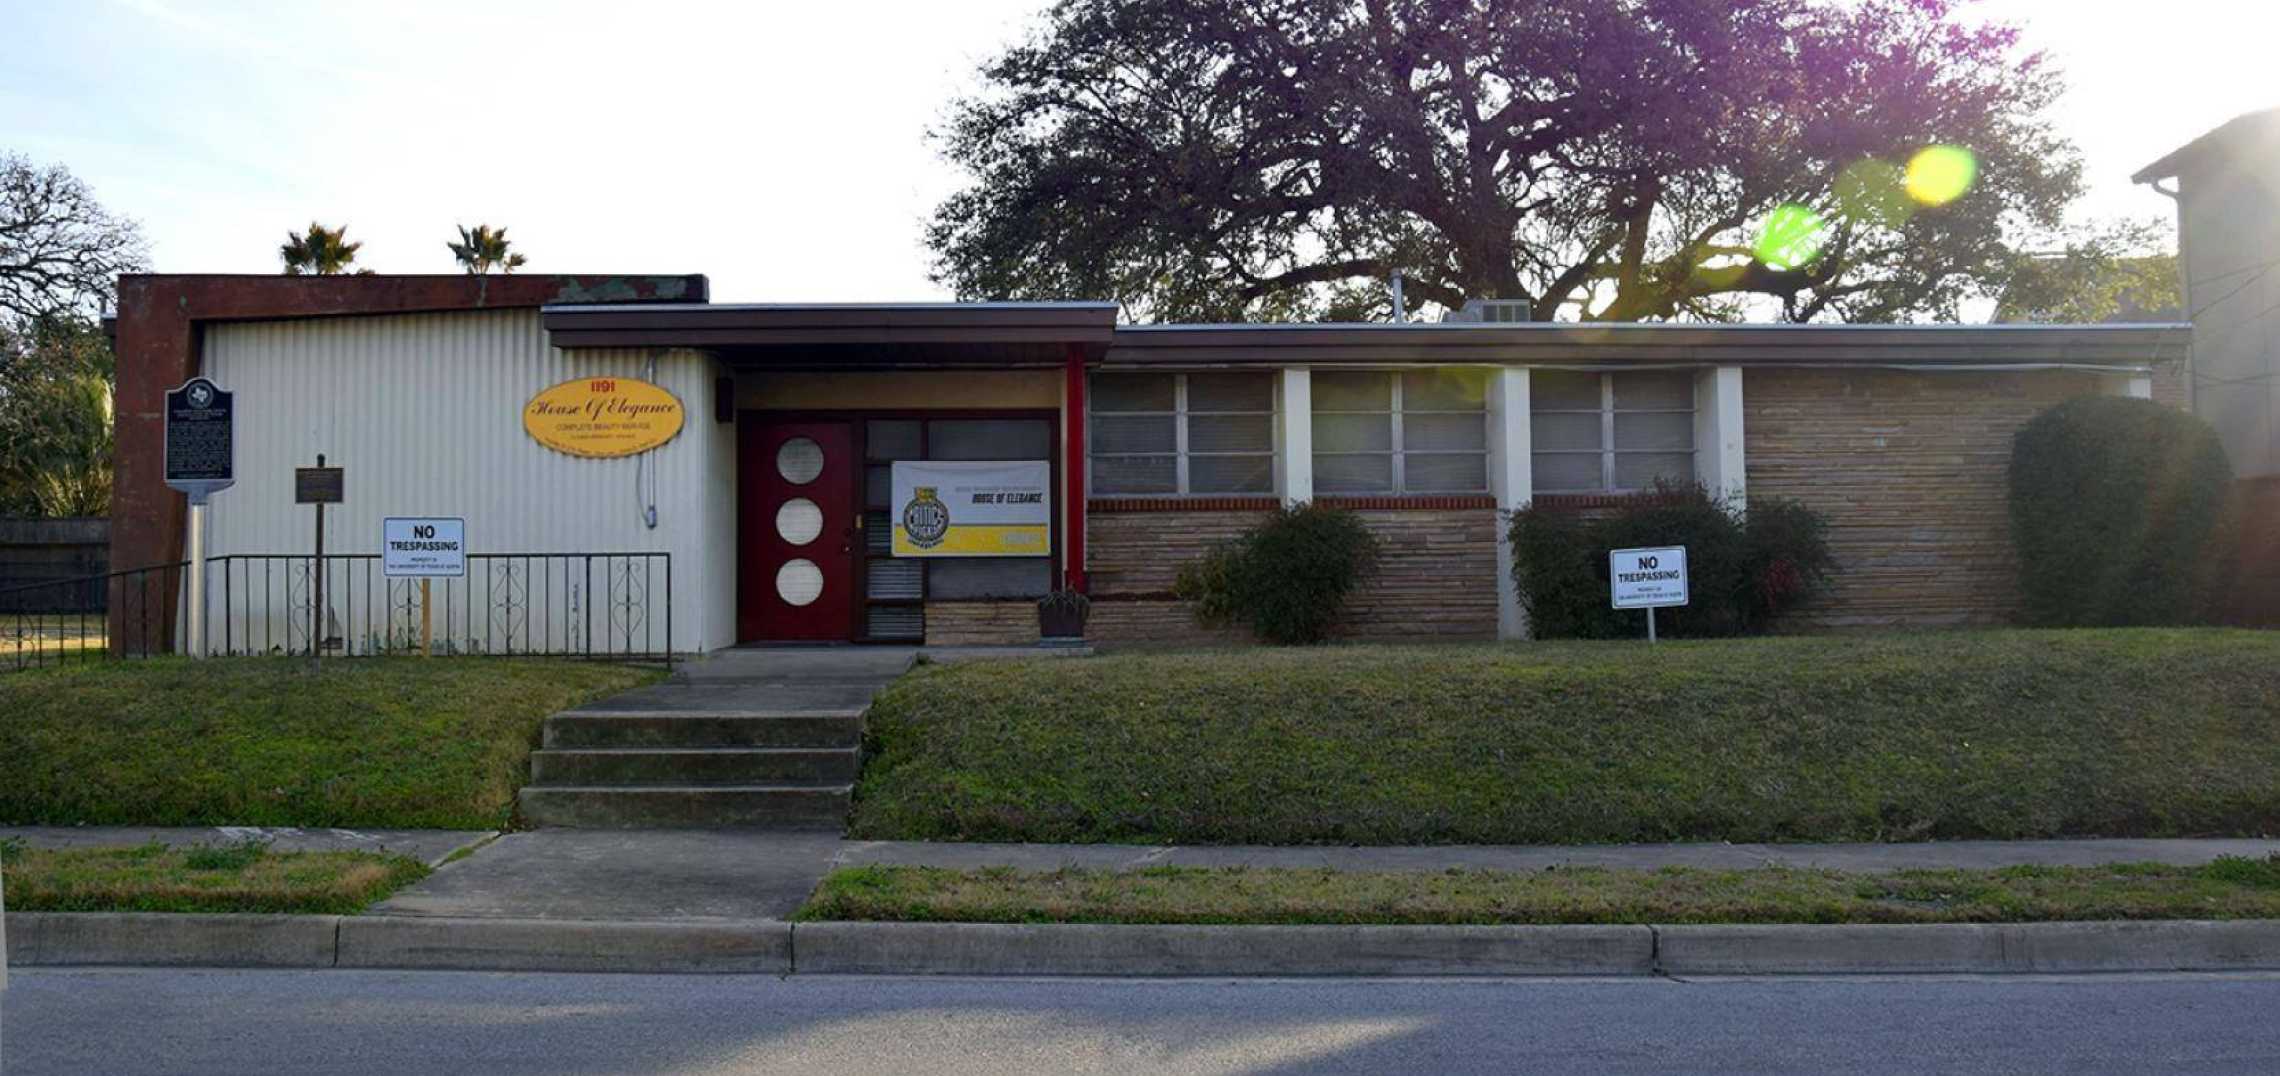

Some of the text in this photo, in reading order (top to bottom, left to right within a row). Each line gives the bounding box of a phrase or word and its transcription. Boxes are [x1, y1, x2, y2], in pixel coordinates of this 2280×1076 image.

[591, 380, 615, 392] 1191
[531, 397, 676, 421] House Of Elegance
[414, 525, 435, 539] NO
[390, 541, 459, 551] TRESPASSING
[1638, 556, 1658, 570] NO
[1618, 570, 1680, 583] TRESPASSING
